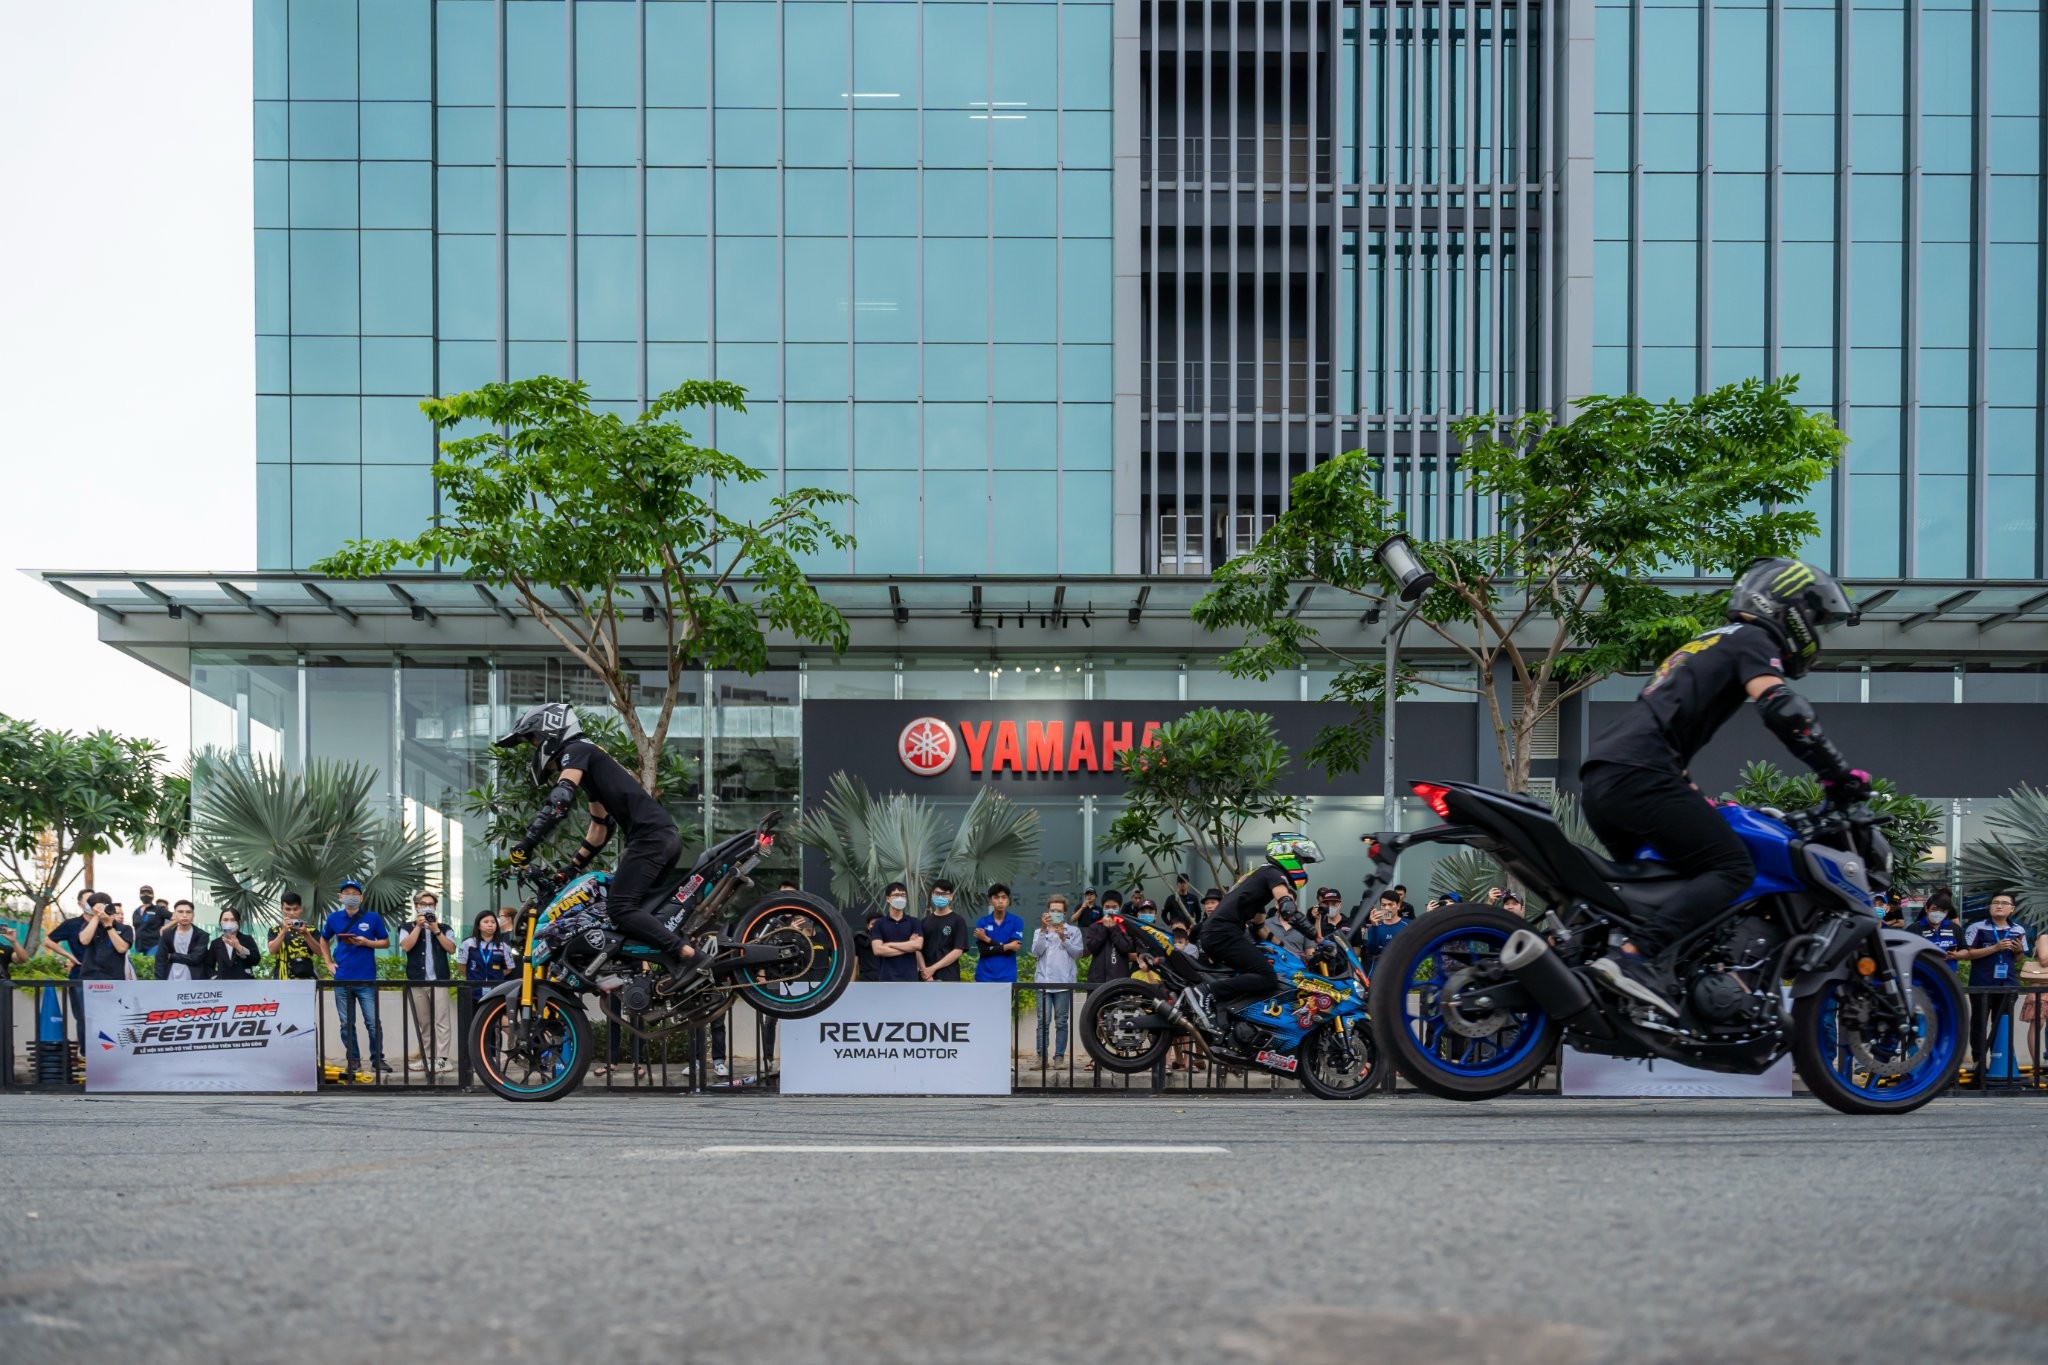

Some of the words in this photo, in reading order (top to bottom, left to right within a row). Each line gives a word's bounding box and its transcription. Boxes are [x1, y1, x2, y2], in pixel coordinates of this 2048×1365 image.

[547, 890, 591, 923] STUNT
[177, 991, 224, 1001] REVZONE
[145, 1006, 229, 1025] SPORT
[232, 1003, 280, 1019] BIKE
[820, 1021, 971, 1044] REVZONE
[834, 1048, 899, 1059] YAMAHA
[903, 1048, 958, 1059] MOTOR
